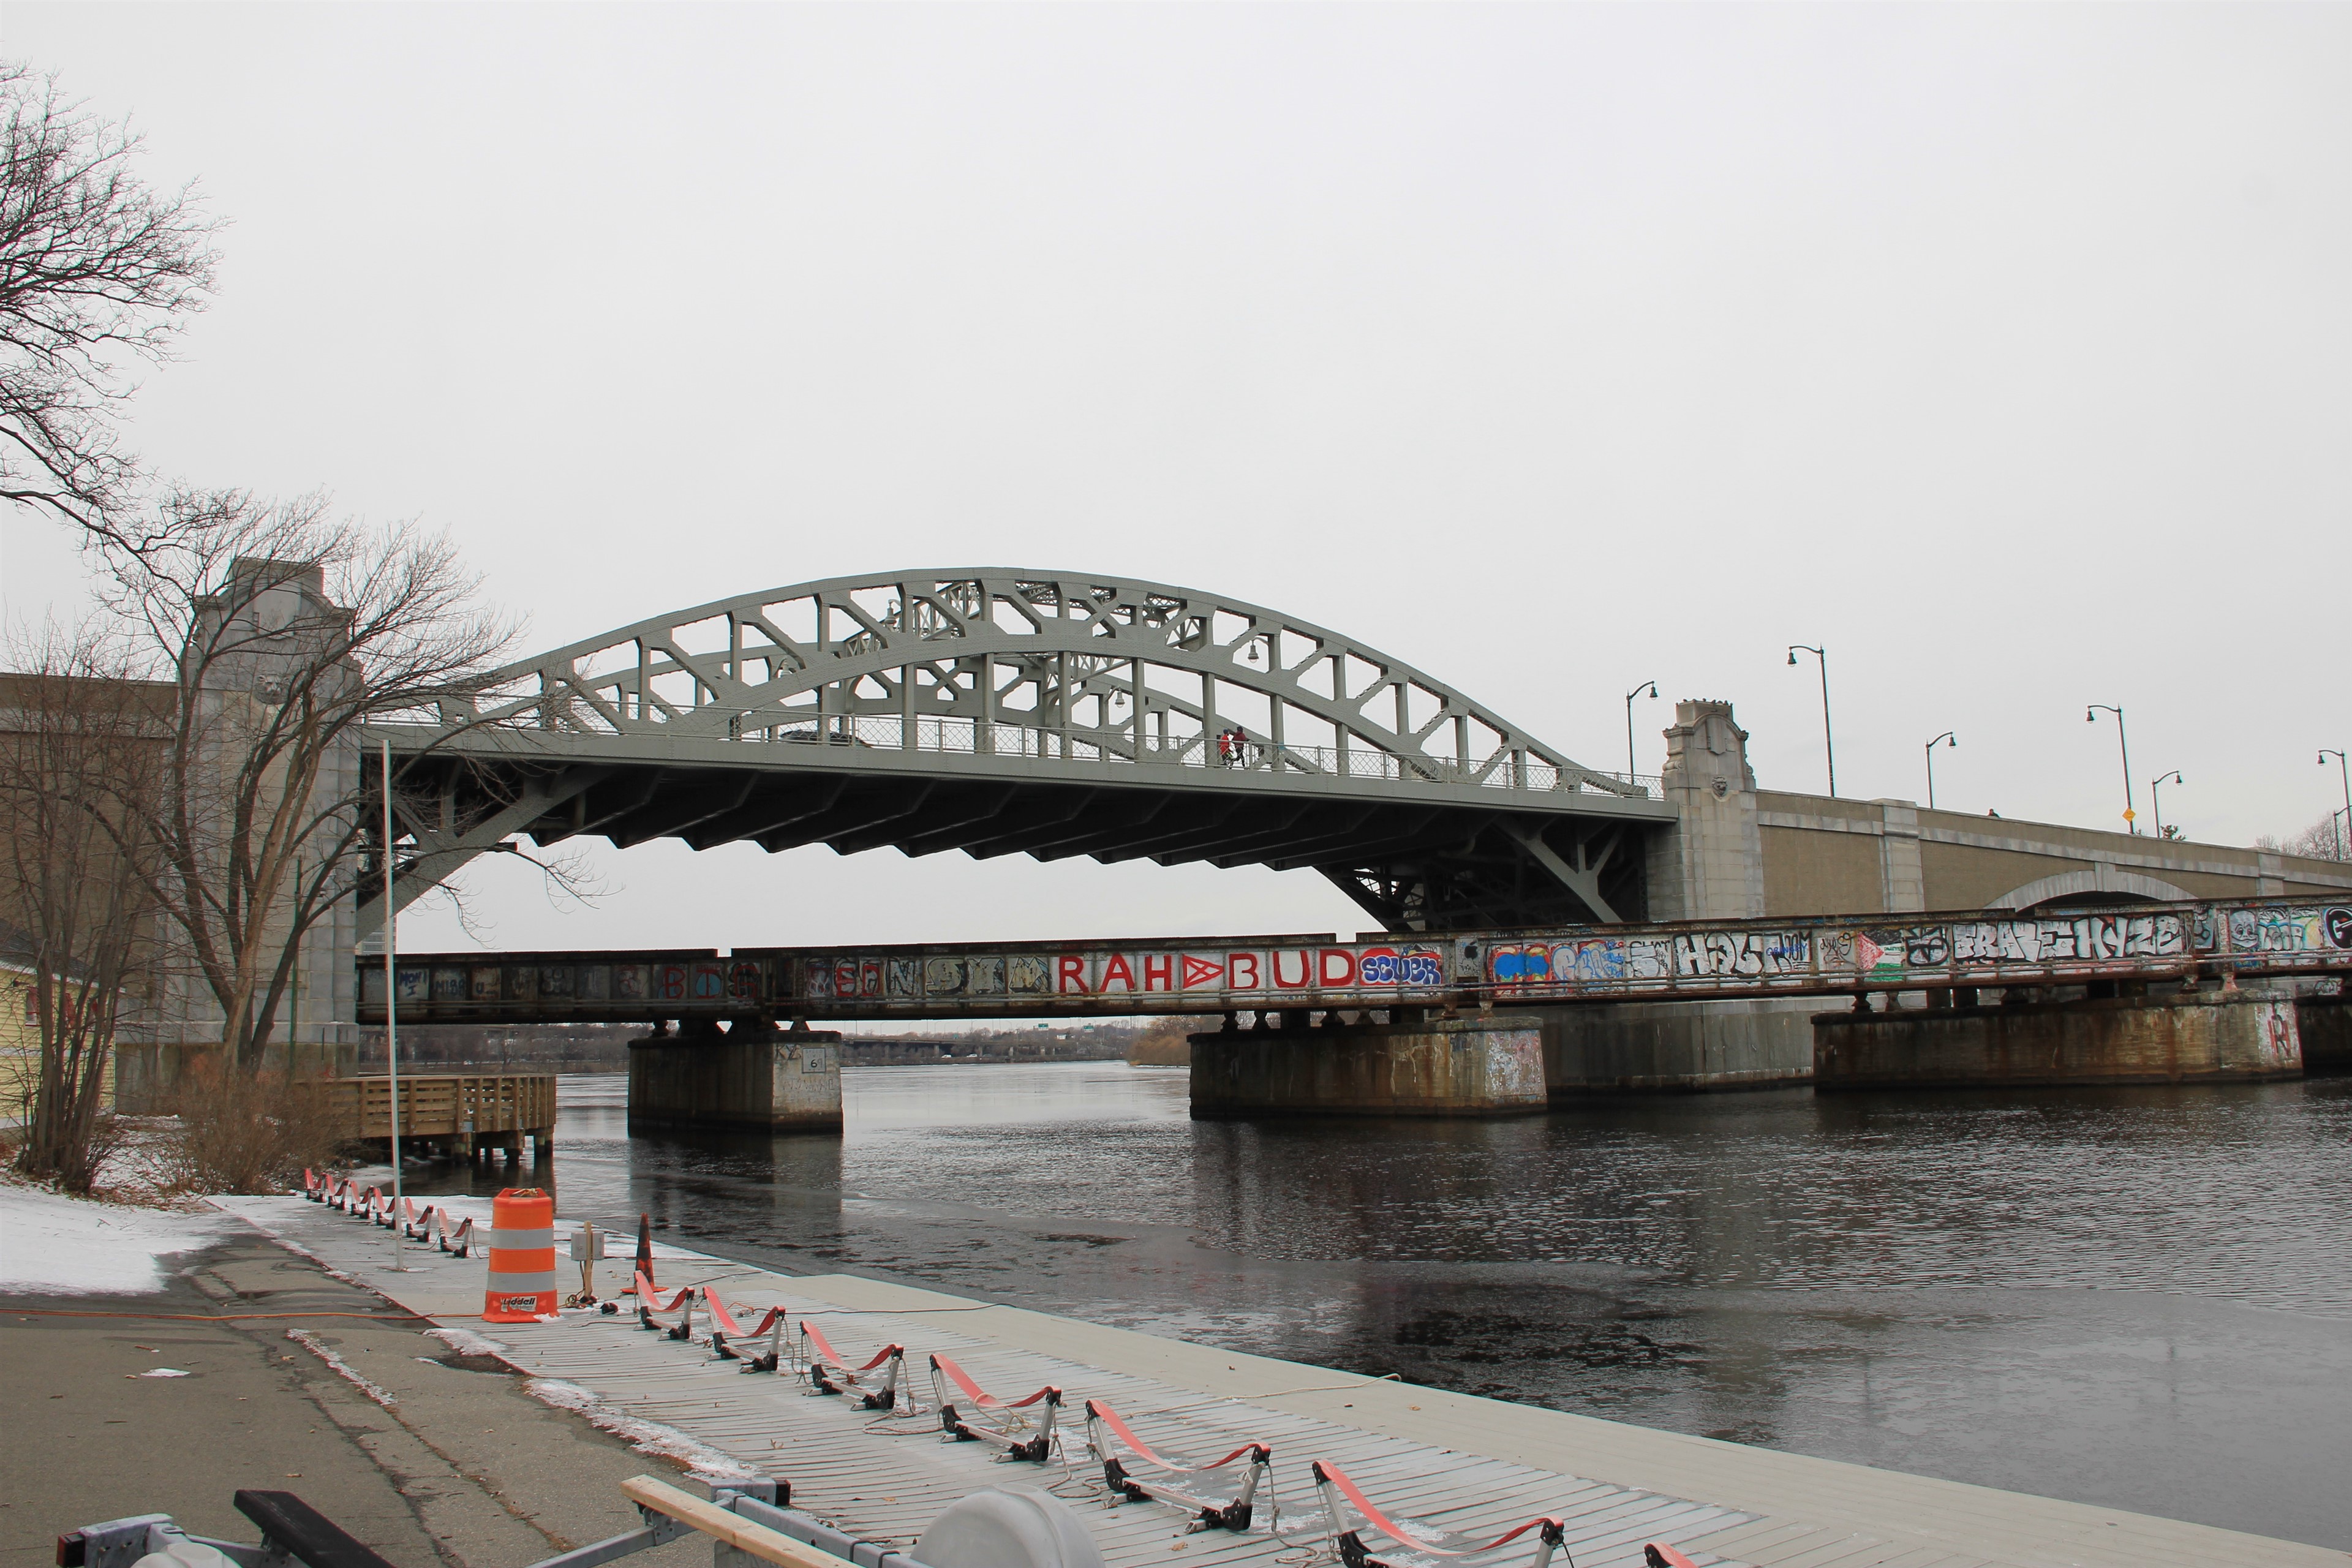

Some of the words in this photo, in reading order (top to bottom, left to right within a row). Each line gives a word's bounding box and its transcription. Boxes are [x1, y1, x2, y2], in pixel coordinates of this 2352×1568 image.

[664, 965, 759, 1000] BIG
[1059, 952, 1172, 993] RAH
[1229, 949, 1355, 989] BUD
